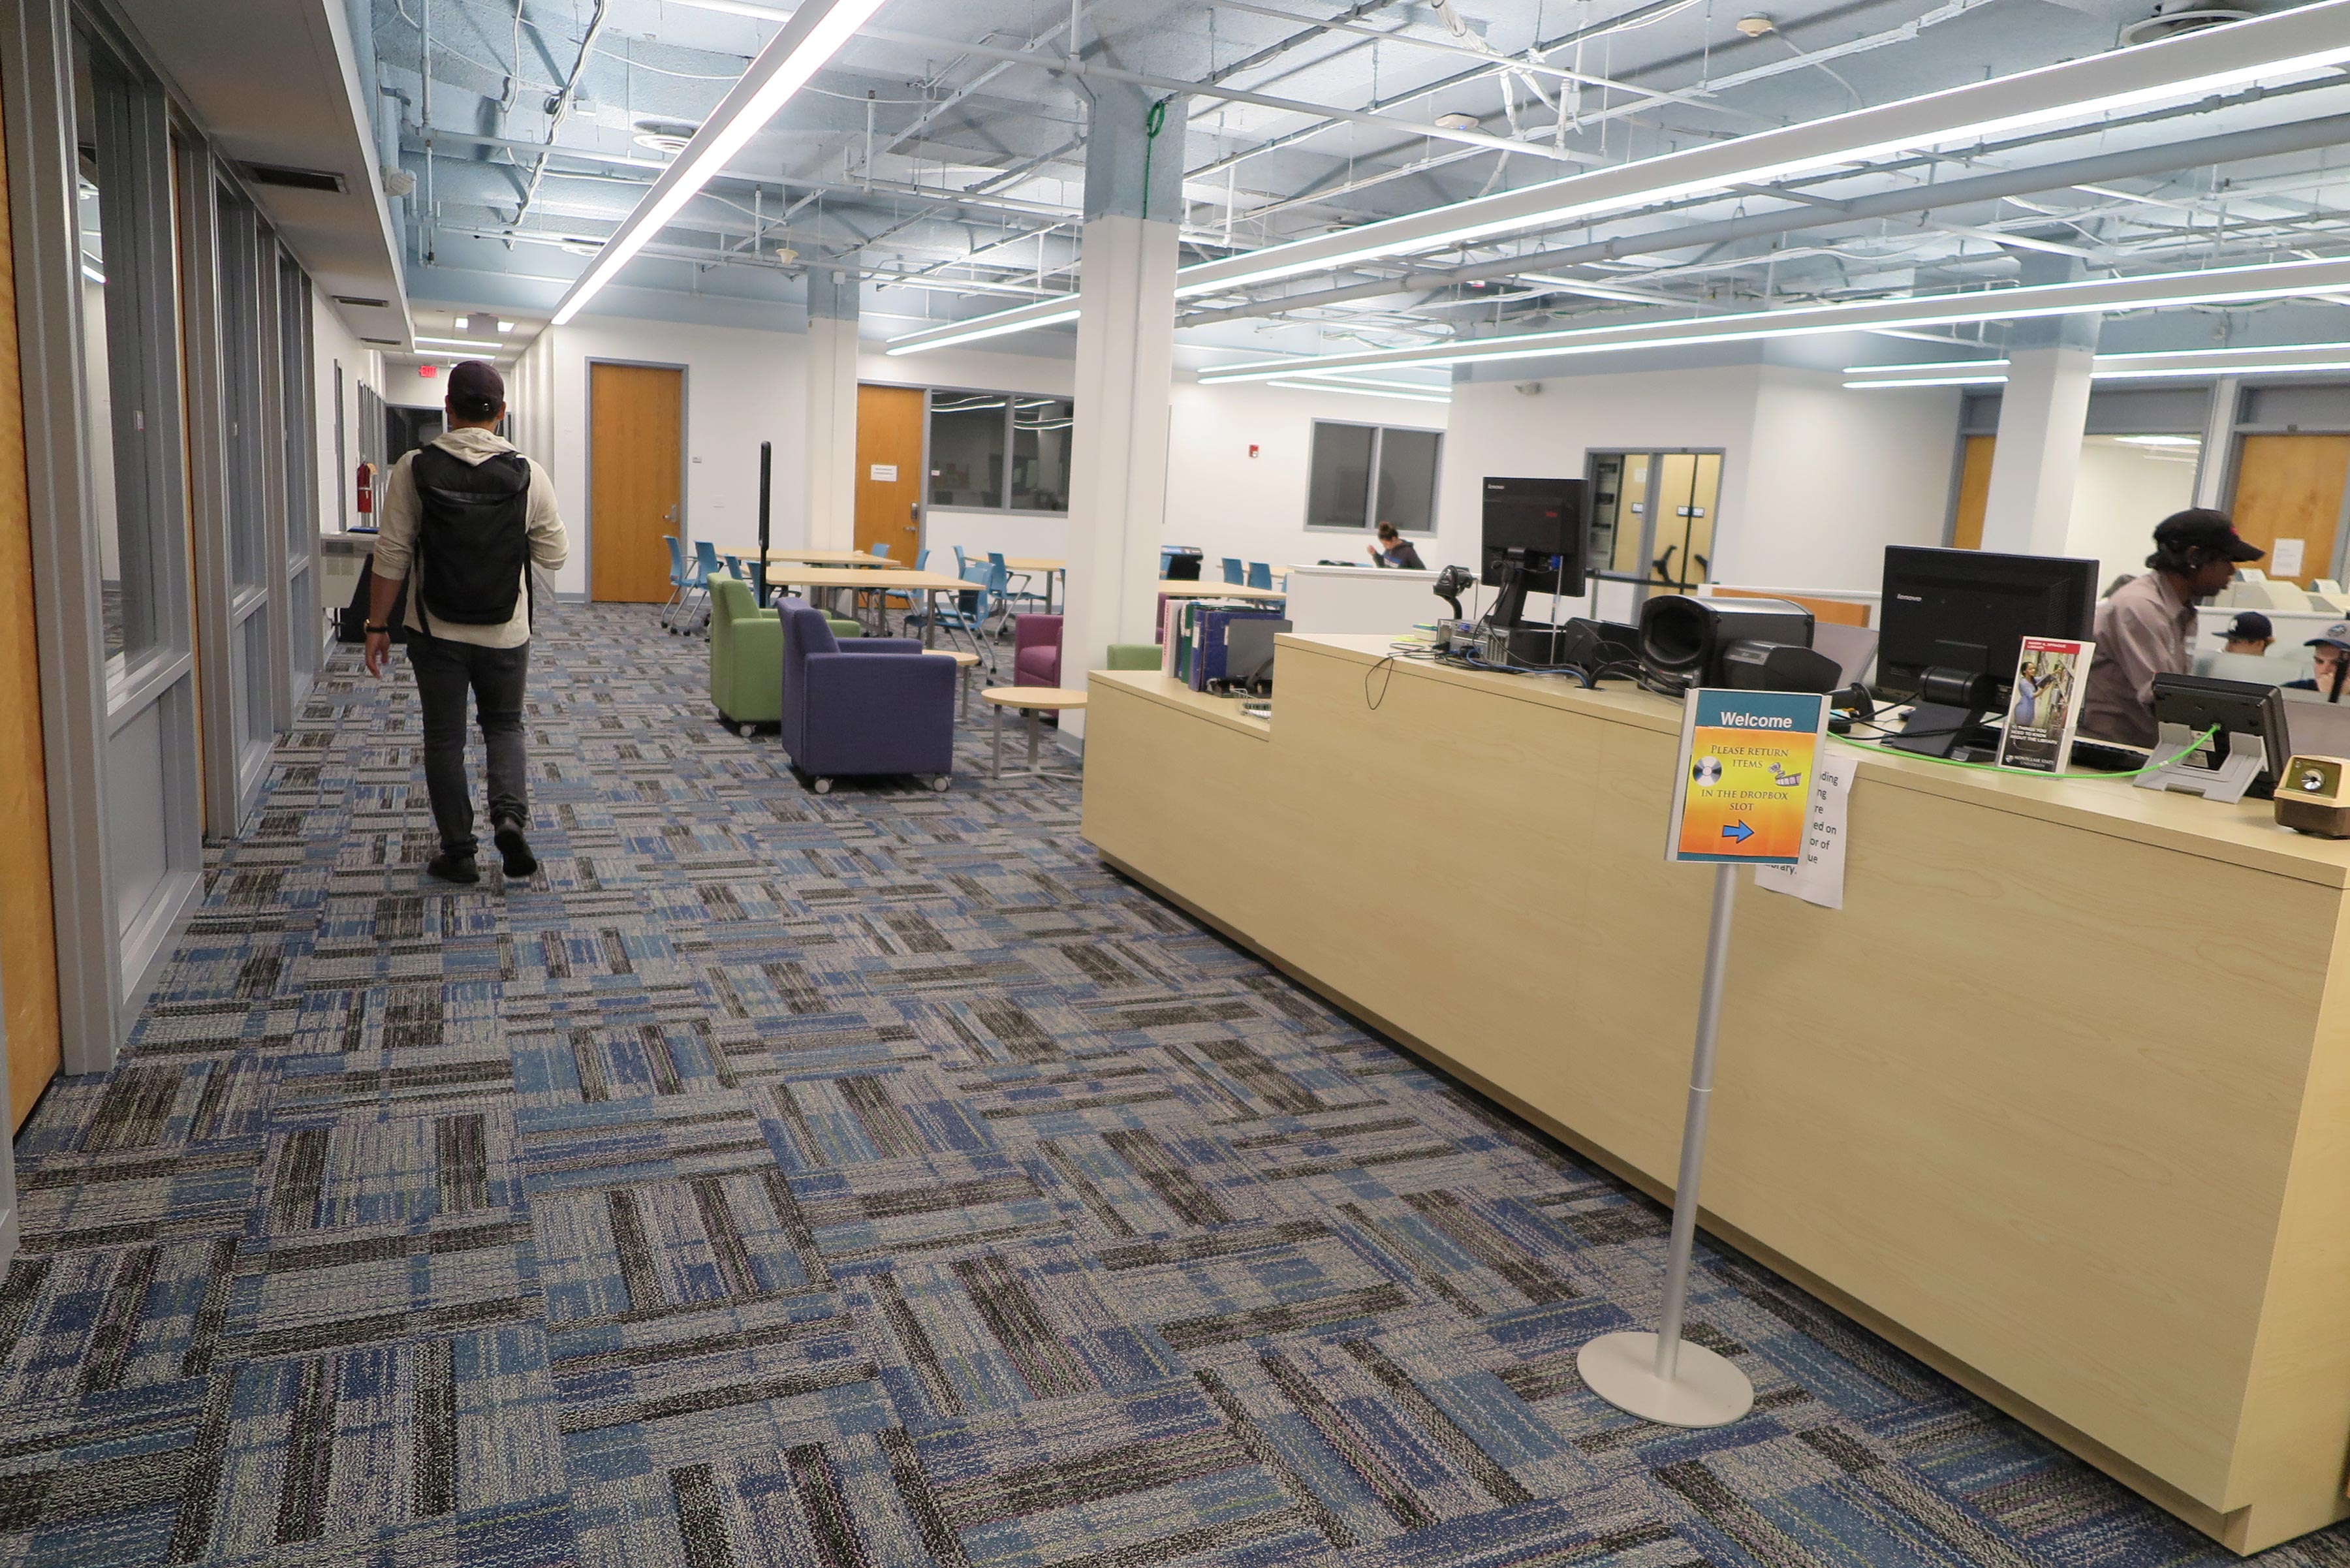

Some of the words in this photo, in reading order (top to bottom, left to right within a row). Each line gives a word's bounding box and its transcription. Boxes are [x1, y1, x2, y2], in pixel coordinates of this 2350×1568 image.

[421, 366, 437, 377] EXIT
[1897, 593, 1922, 602] lenovo
[1720, 711, 1793, 729] Welcome
[1710, 745, 1745, 755] PLEASE
[1747, 747, 1789, 757] RETURN
[1732, 759, 1763, 768] ITEMS
[1717, 790, 1737, 798] THE
[1740, 791, 1789, 800] DROPBOX
[1729, 802, 1754, 811] SLOT
[1826, 825, 1837, 835] on
[1821, 840, 1830, 850] of
